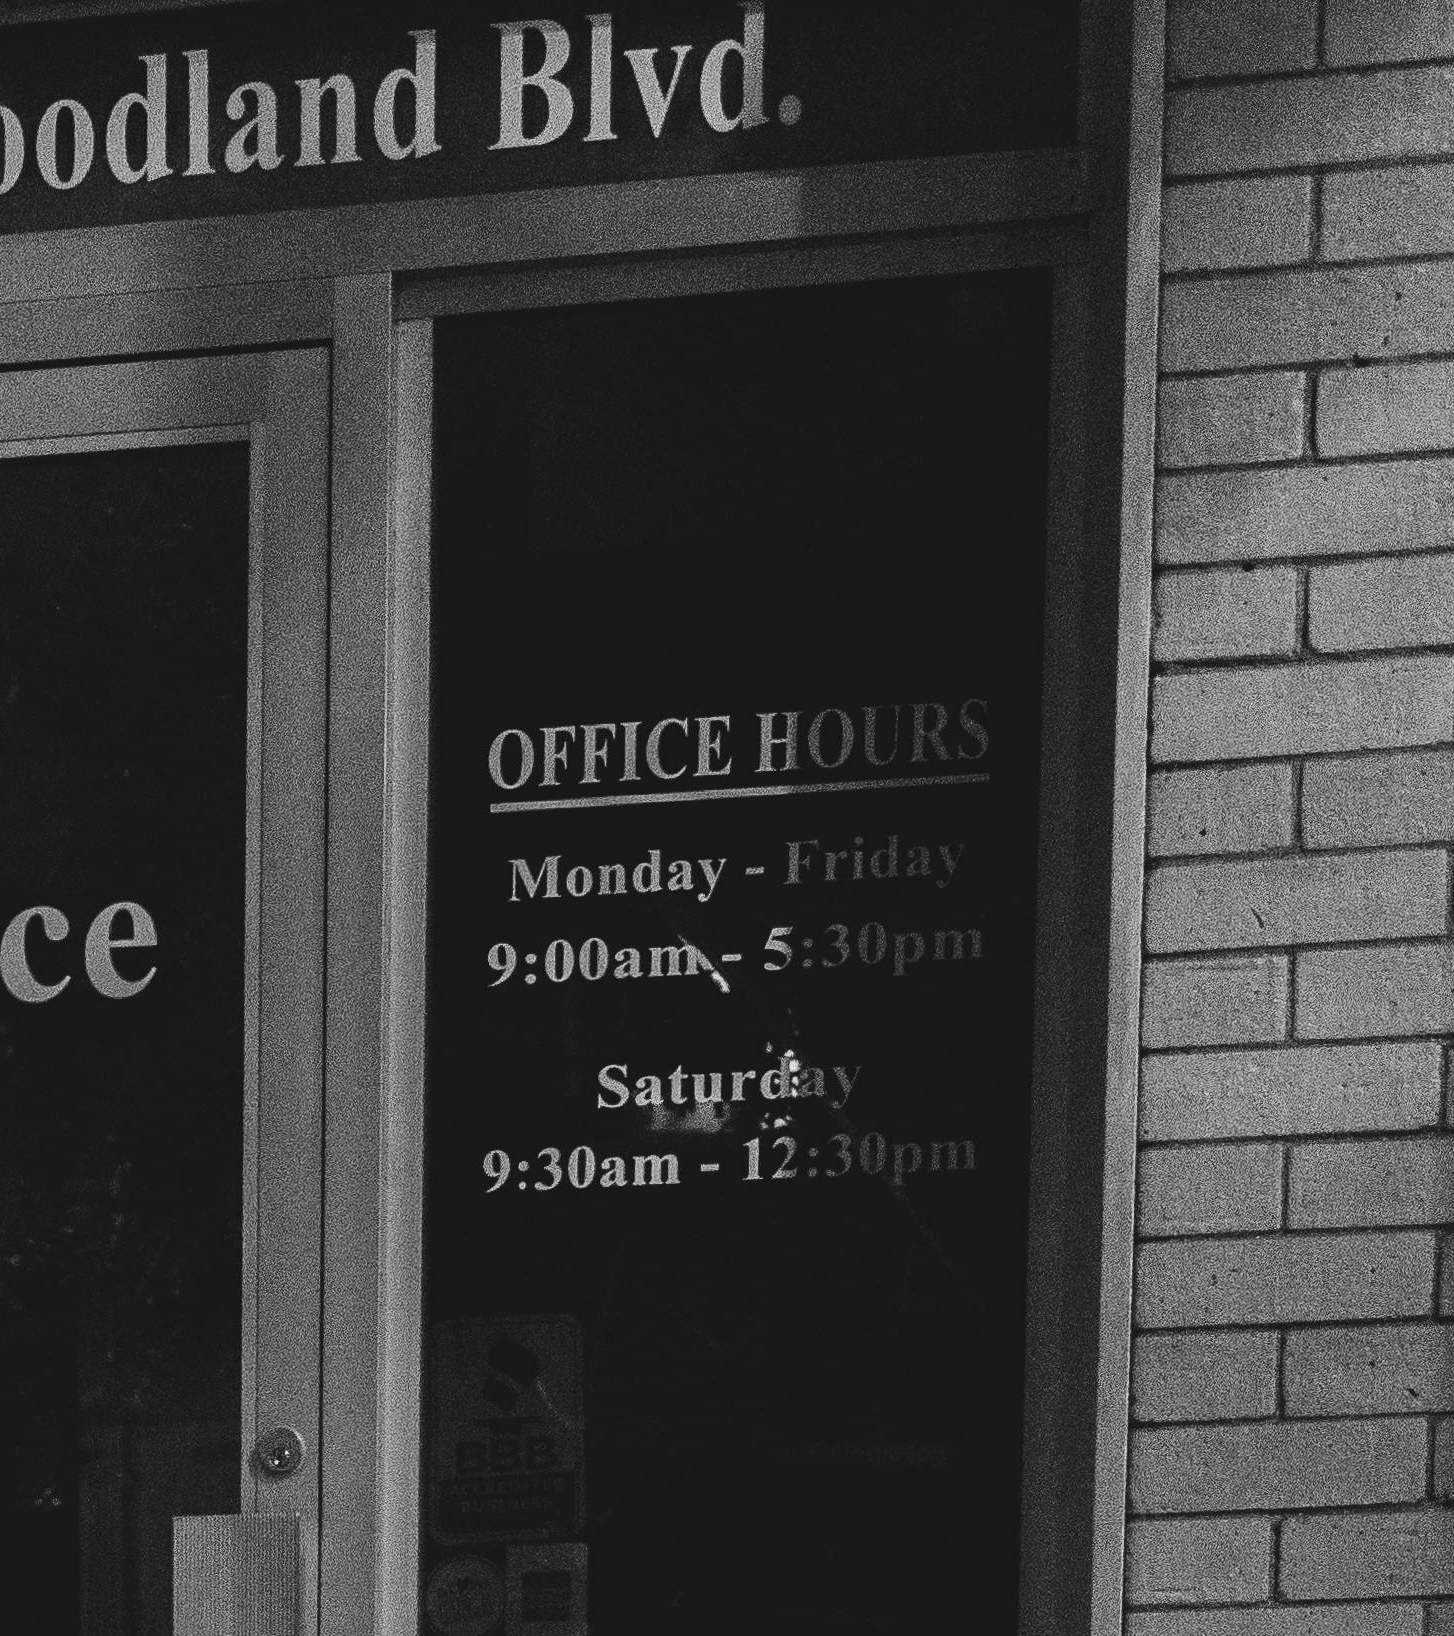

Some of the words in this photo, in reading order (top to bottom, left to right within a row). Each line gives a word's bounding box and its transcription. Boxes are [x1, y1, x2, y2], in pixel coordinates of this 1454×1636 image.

[486, 2, 803, 152] Blvd.
[486, 713, 733, 791] OFFICE
[753, 699, 990, 772] HOURS
[507, 848, 727, 904] Monday
[782, 834, 966, 889] Friday
[486, 935, 702, 988] 9:00am
[761, 920, 985, 977] 5:30pm
[595, 1055, 864, 1110] Saturday
[481, 1143, 683, 1194] 9:30am
[740, 1130, 978, 1189] 12:30pm
[455, 1436, 557, 1473] BBB
